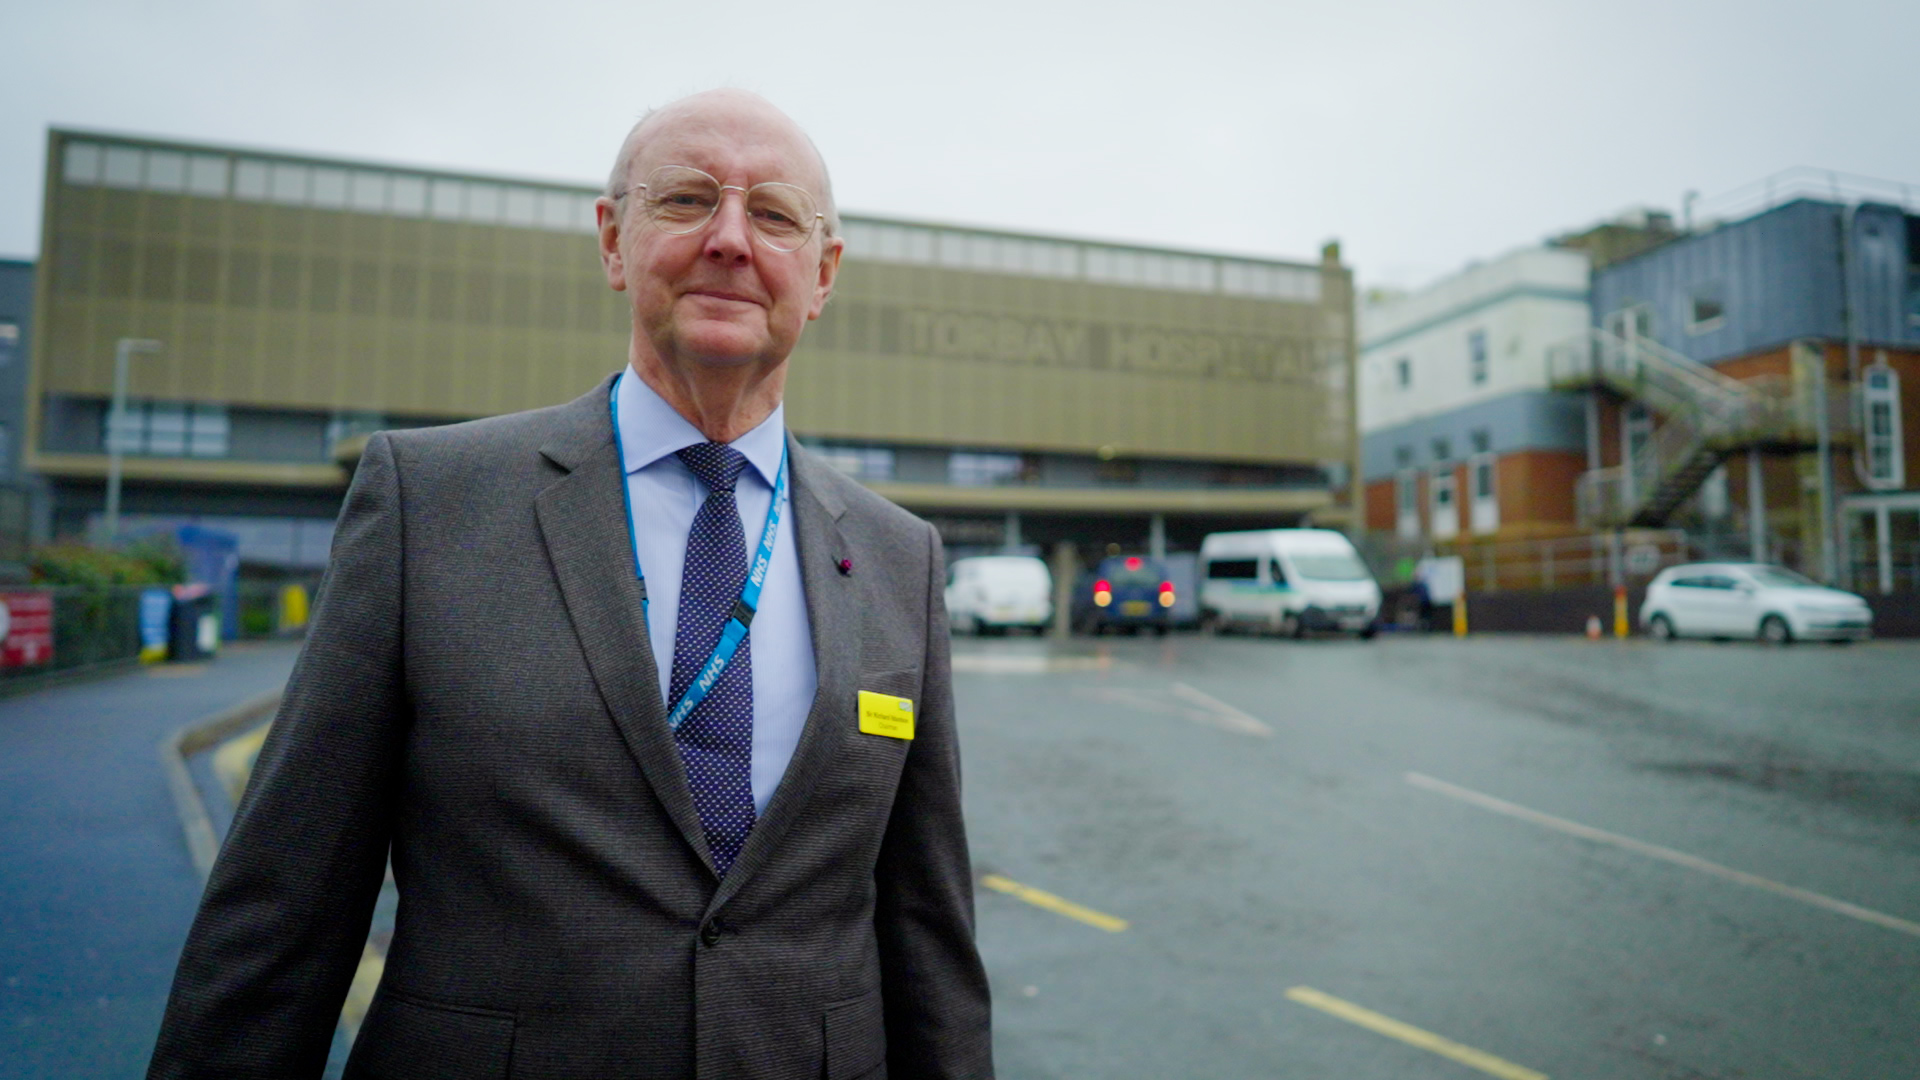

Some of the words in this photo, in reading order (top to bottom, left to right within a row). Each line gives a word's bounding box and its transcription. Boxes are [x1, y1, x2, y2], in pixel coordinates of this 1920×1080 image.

[904, 307, 1089, 365] TORBAY
[764, 523, 777, 551] NHS
[751, 554, 768, 587] NHS
[699, 653, 725, 692] NHS
[669, 696, 694, 729] NHS
